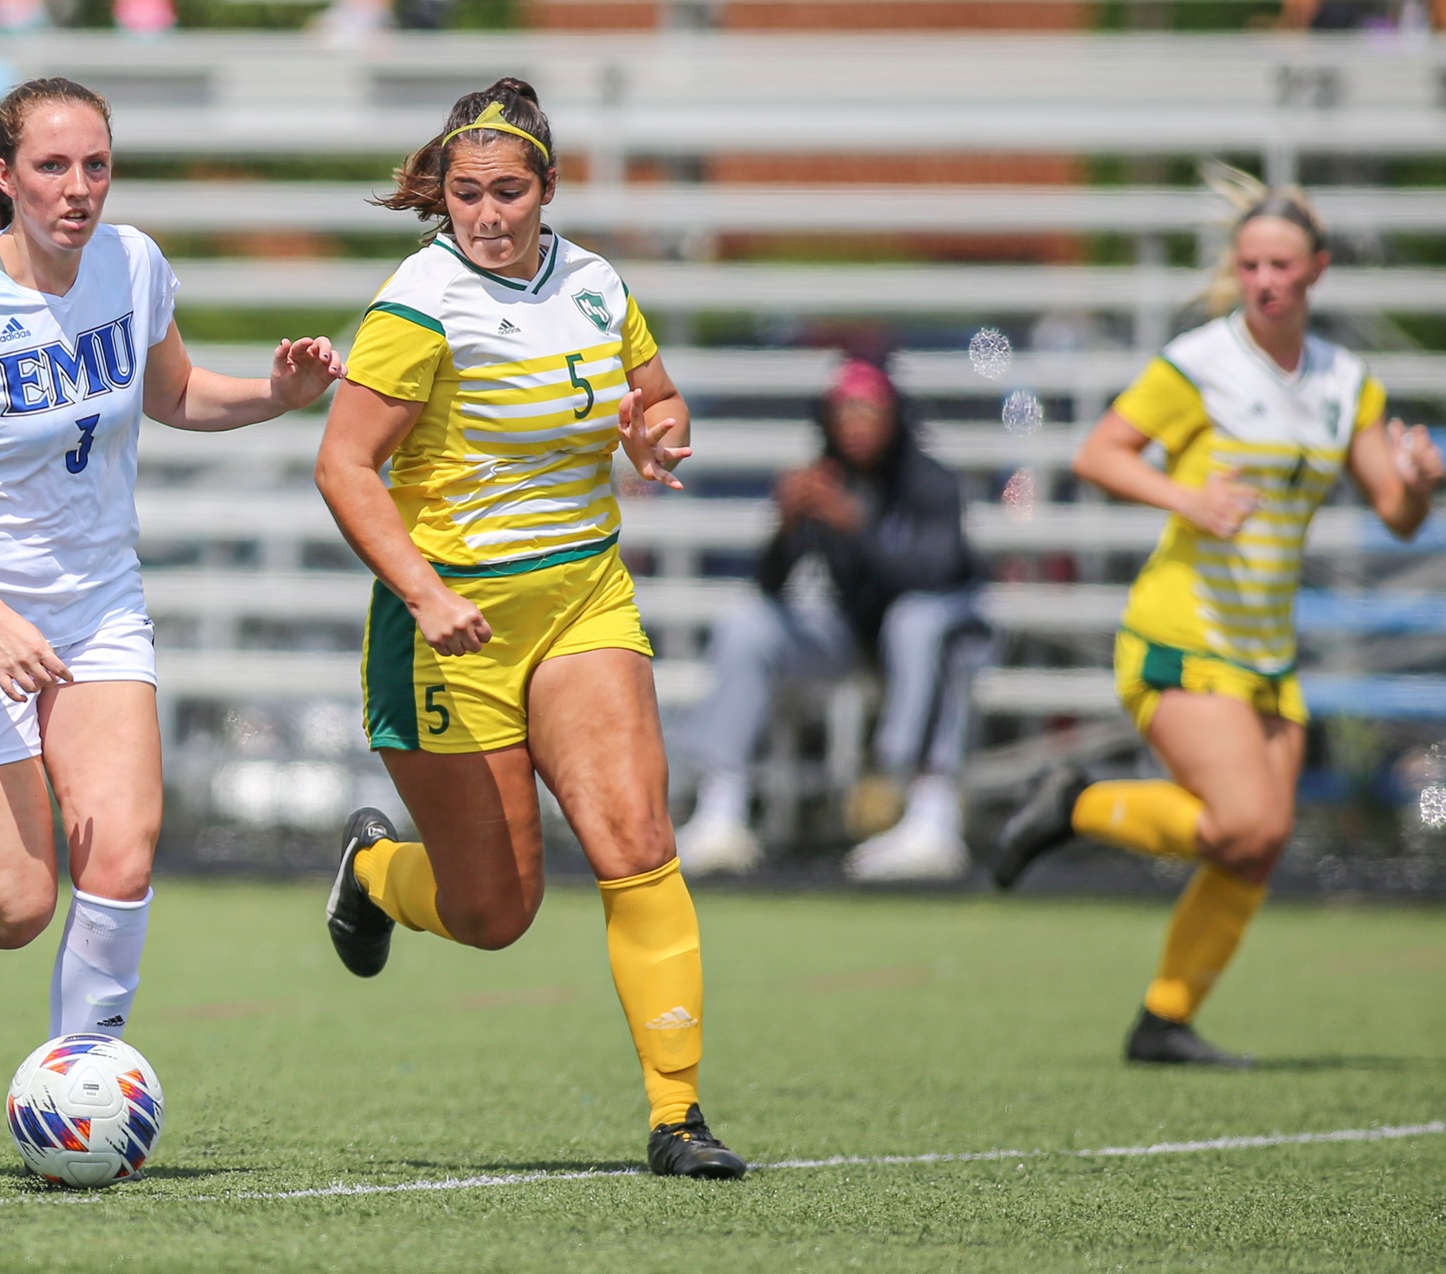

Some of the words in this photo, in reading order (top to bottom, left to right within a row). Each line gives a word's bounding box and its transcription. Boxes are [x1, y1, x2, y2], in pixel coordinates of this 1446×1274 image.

[0, 329, 31, 342] adidas
[565, 353, 594, 420] 5
[65, 413, 100, 474] 3
[425, 684, 450, 735] 5
